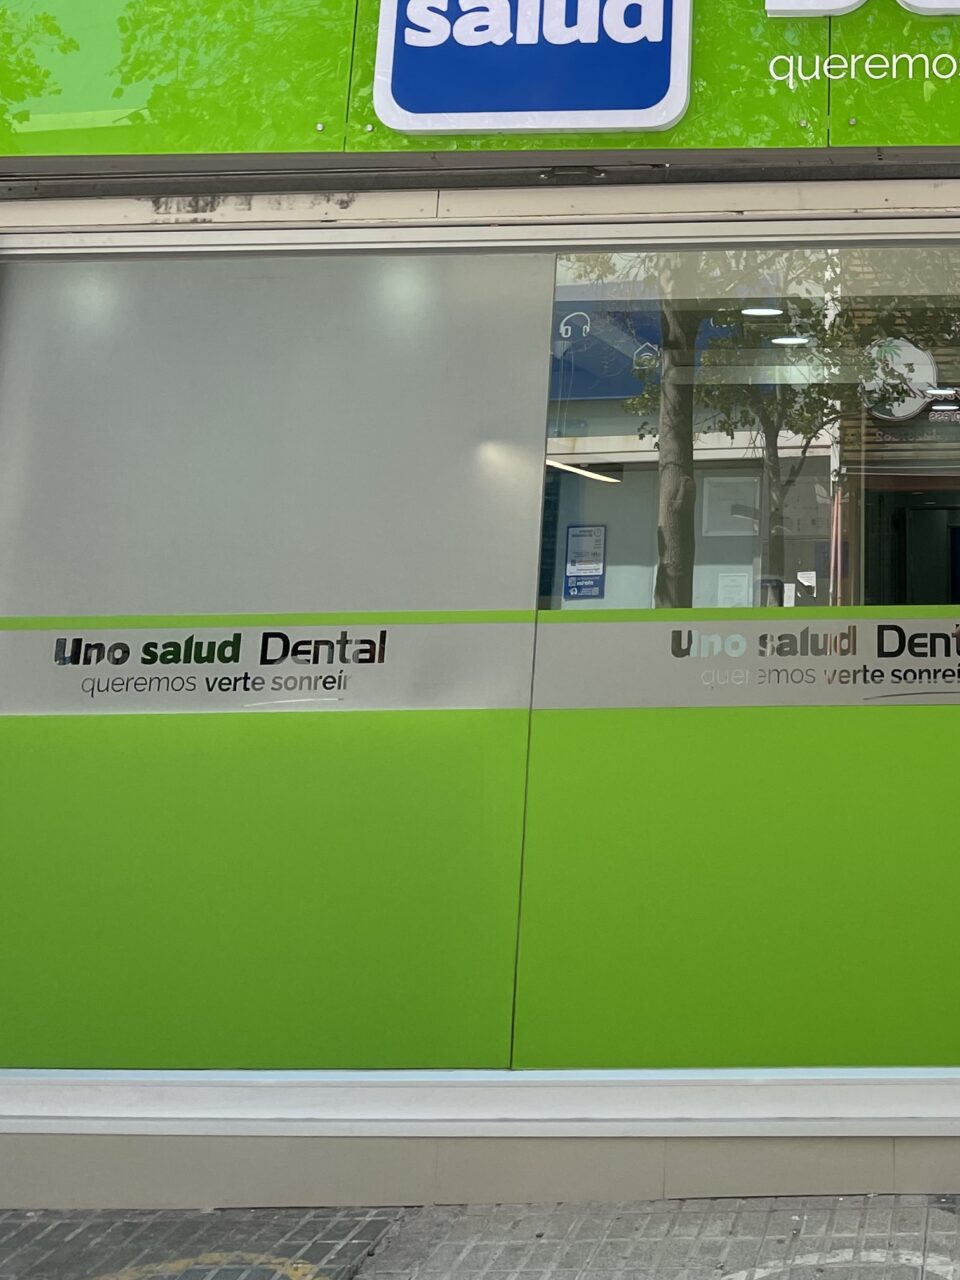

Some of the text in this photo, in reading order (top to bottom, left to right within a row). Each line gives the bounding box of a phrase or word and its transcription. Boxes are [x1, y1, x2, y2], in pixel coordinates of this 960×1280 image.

[140, 632, 243, 665] salud
[259, 629, 387, 665] Dental
[758, 625, 857, 657] salud
[81, 669, 352, 698] queremos verte sonreír
[824, 663, 885, 685] verte
